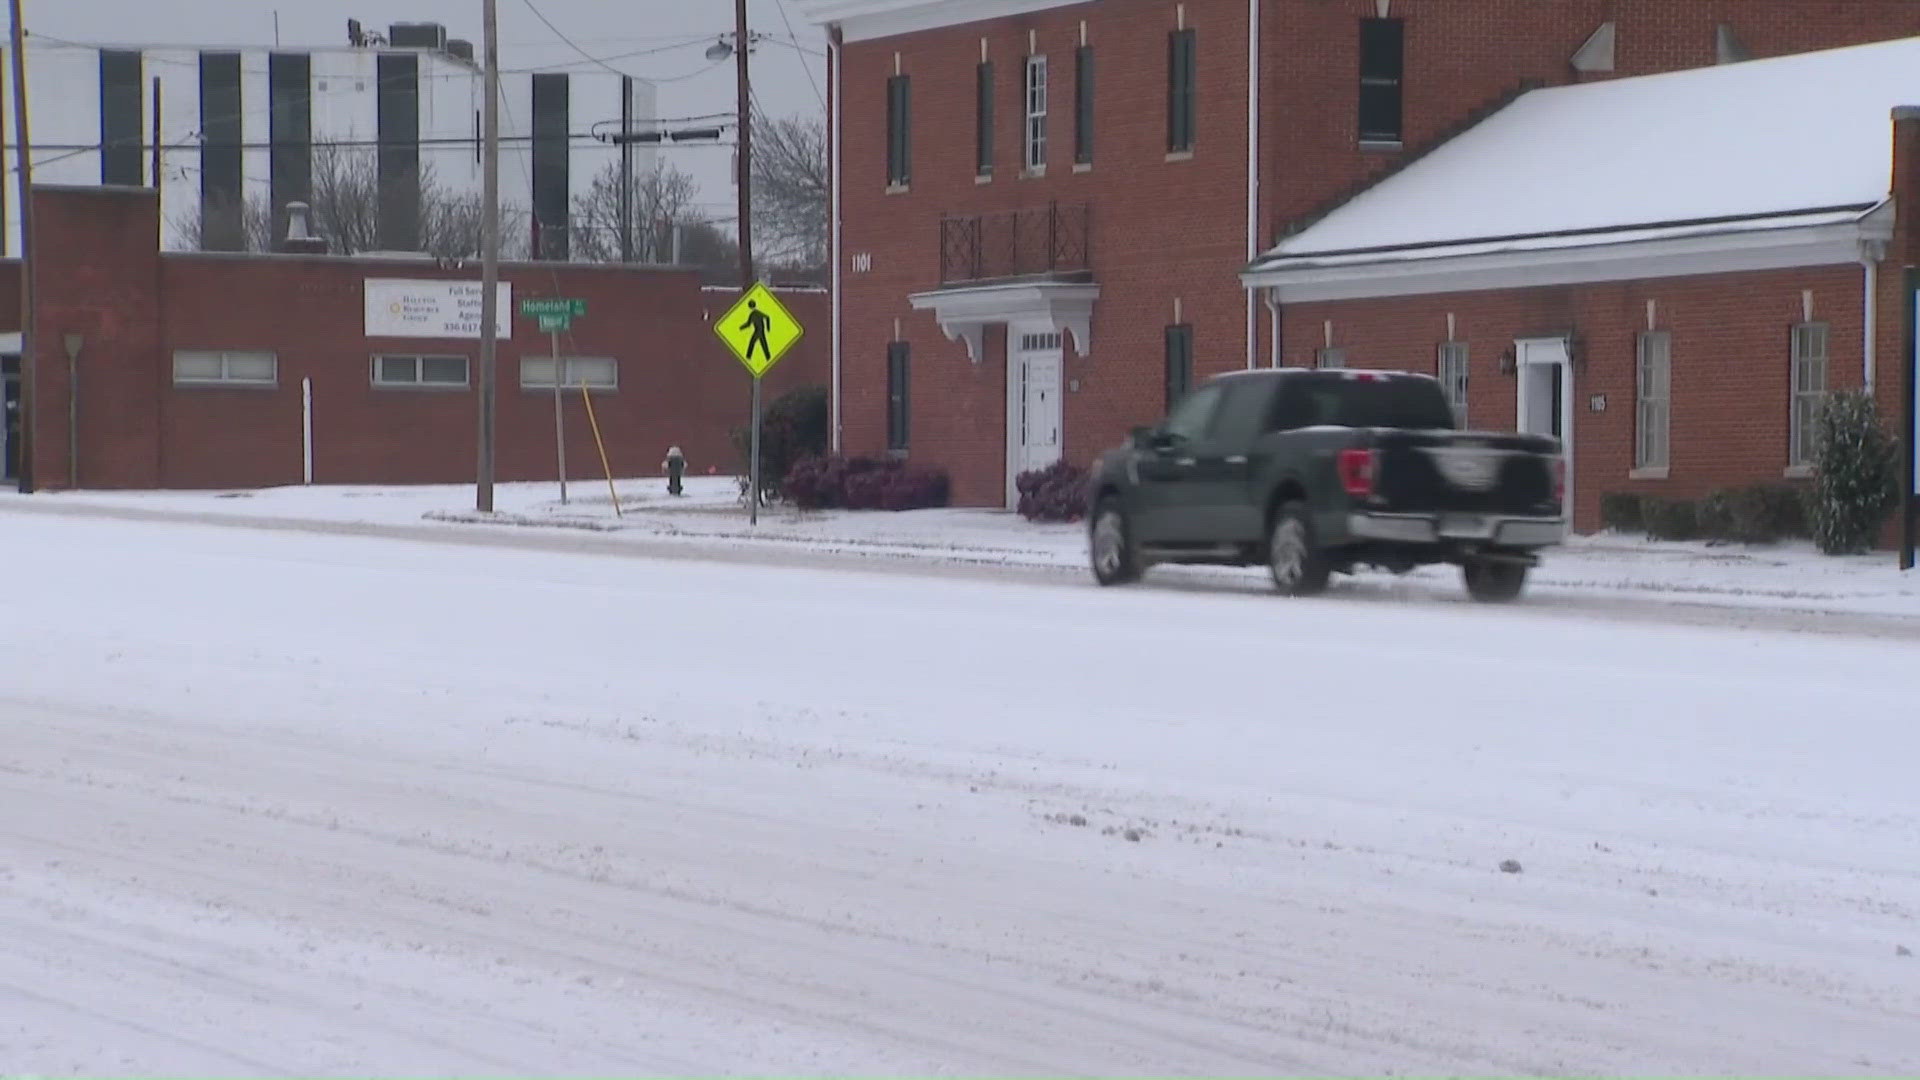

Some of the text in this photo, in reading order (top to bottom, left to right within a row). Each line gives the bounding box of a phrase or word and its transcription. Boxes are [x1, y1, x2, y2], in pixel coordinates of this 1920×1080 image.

[851, 252, 871, 272] 1101
[449, 286, 464, 296] Full
[522, 299, 570, 313] Homeland
